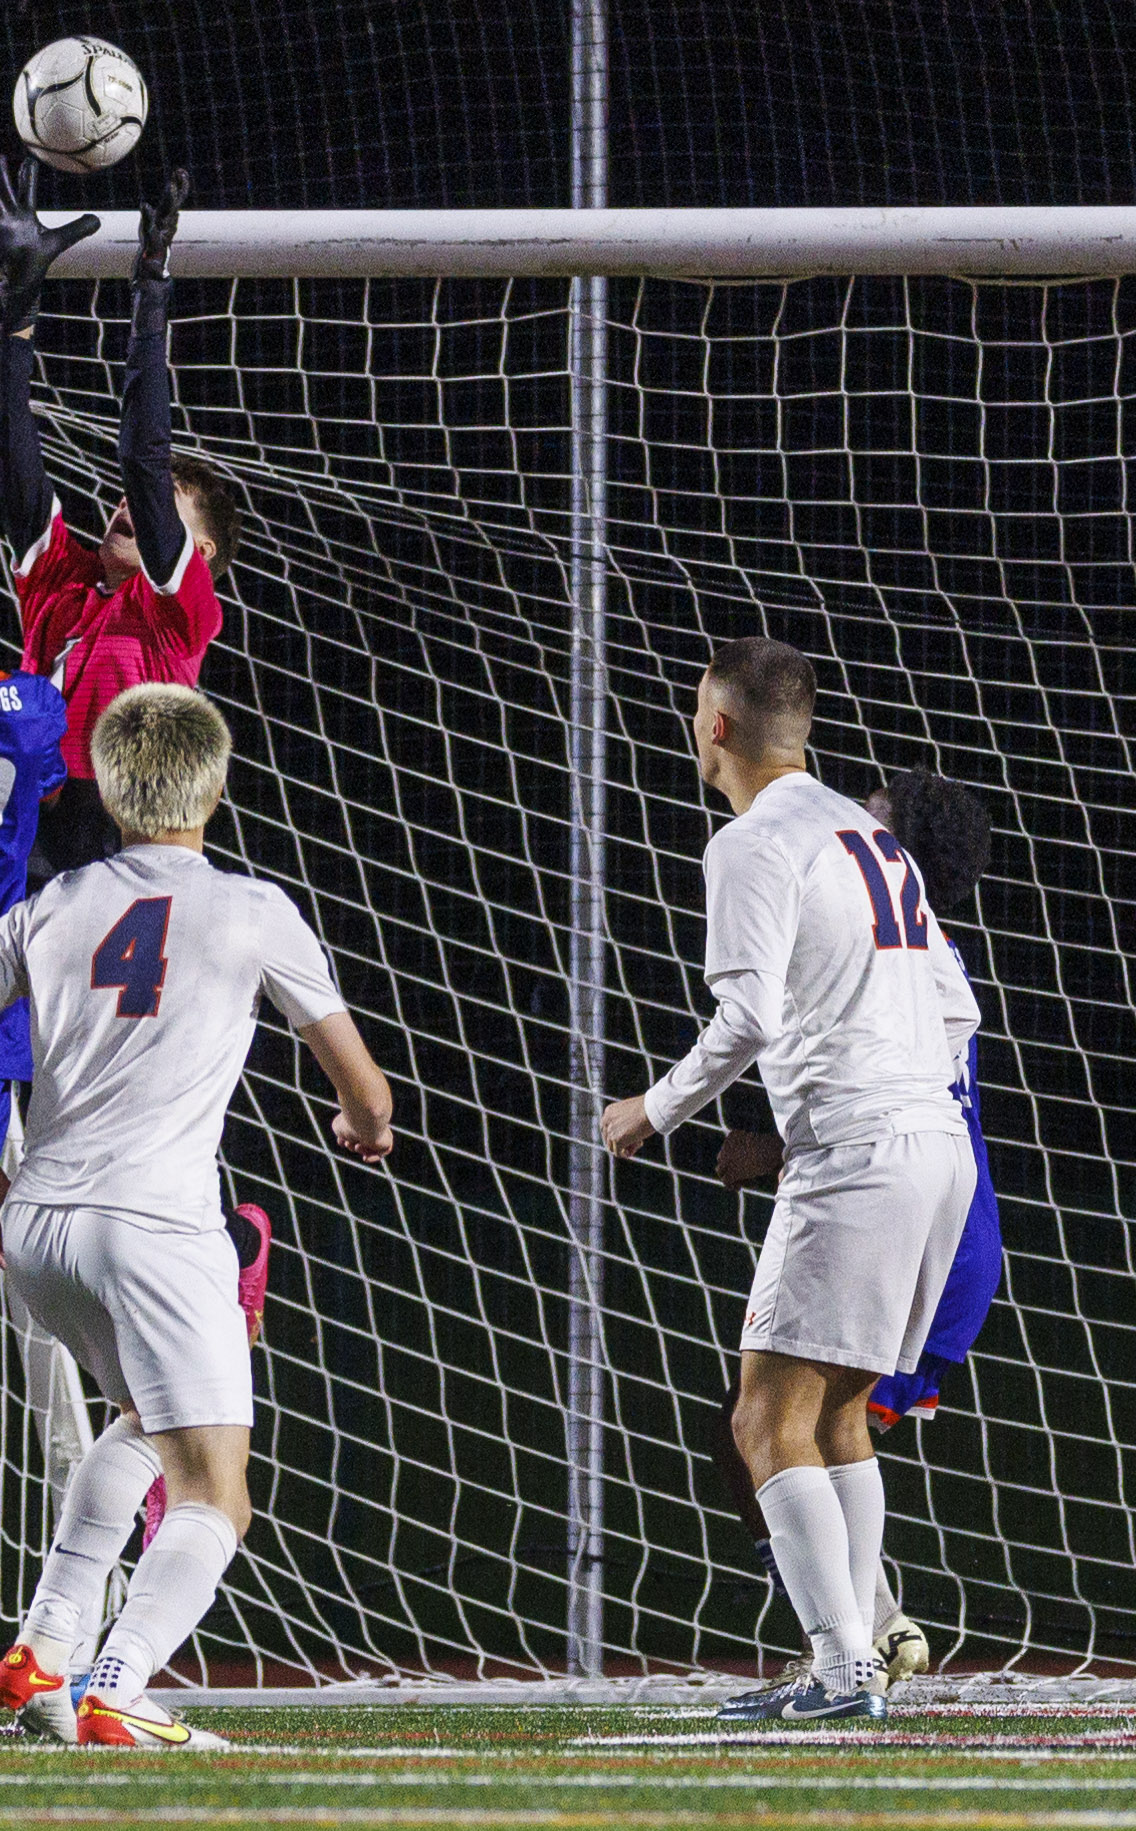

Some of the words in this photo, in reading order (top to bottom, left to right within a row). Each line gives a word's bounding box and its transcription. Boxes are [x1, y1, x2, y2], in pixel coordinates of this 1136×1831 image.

[81, 44, 128, 62] SPAL
[835, 829, 929, 950] 12
[91, 895, 173, 1018] 4
